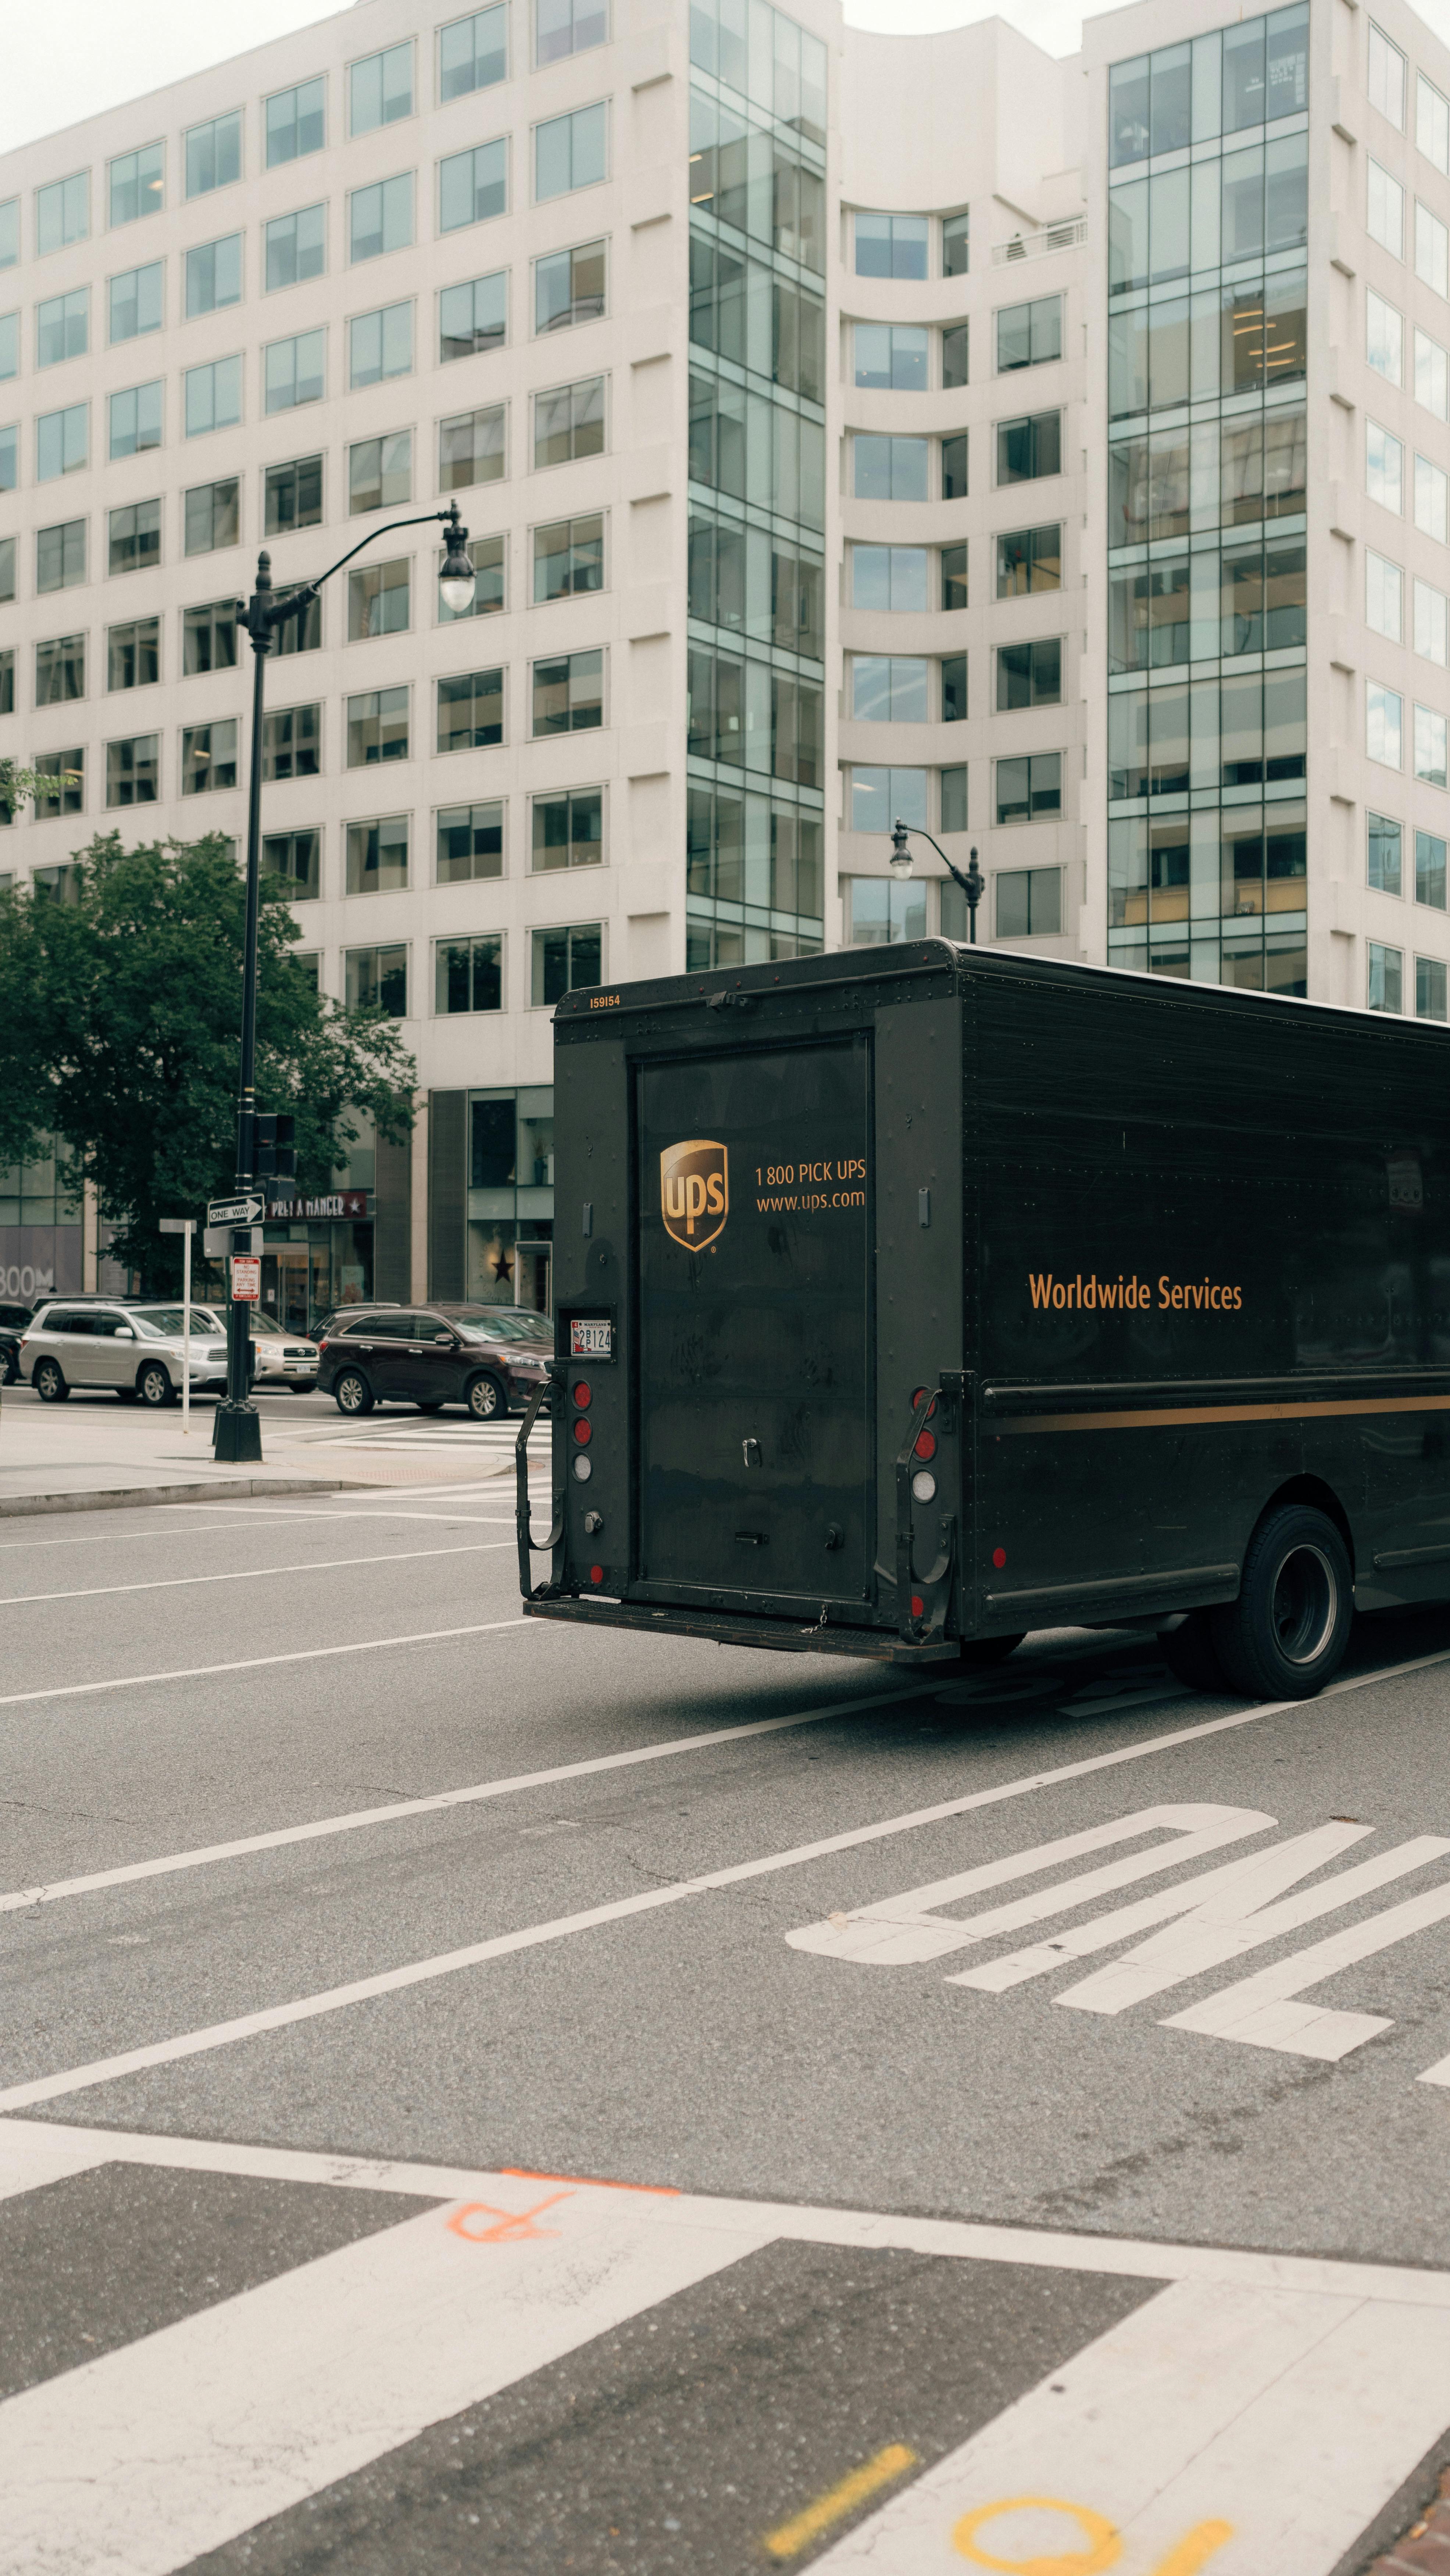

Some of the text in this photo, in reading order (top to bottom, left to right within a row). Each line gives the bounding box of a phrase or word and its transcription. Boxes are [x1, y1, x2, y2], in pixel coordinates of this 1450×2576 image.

[590, 995, 620, 1009] 159154
[756, 1159, 865, 1186] 1 800 PICK UPS
[211, 1206, 250, 1220] ONE WAY
[666, 1173, 724, 1234] ups
[757, 1191, 865, 1214] www.ups.com
[1029, 1274, 1242, 1309] Worldwide Services
